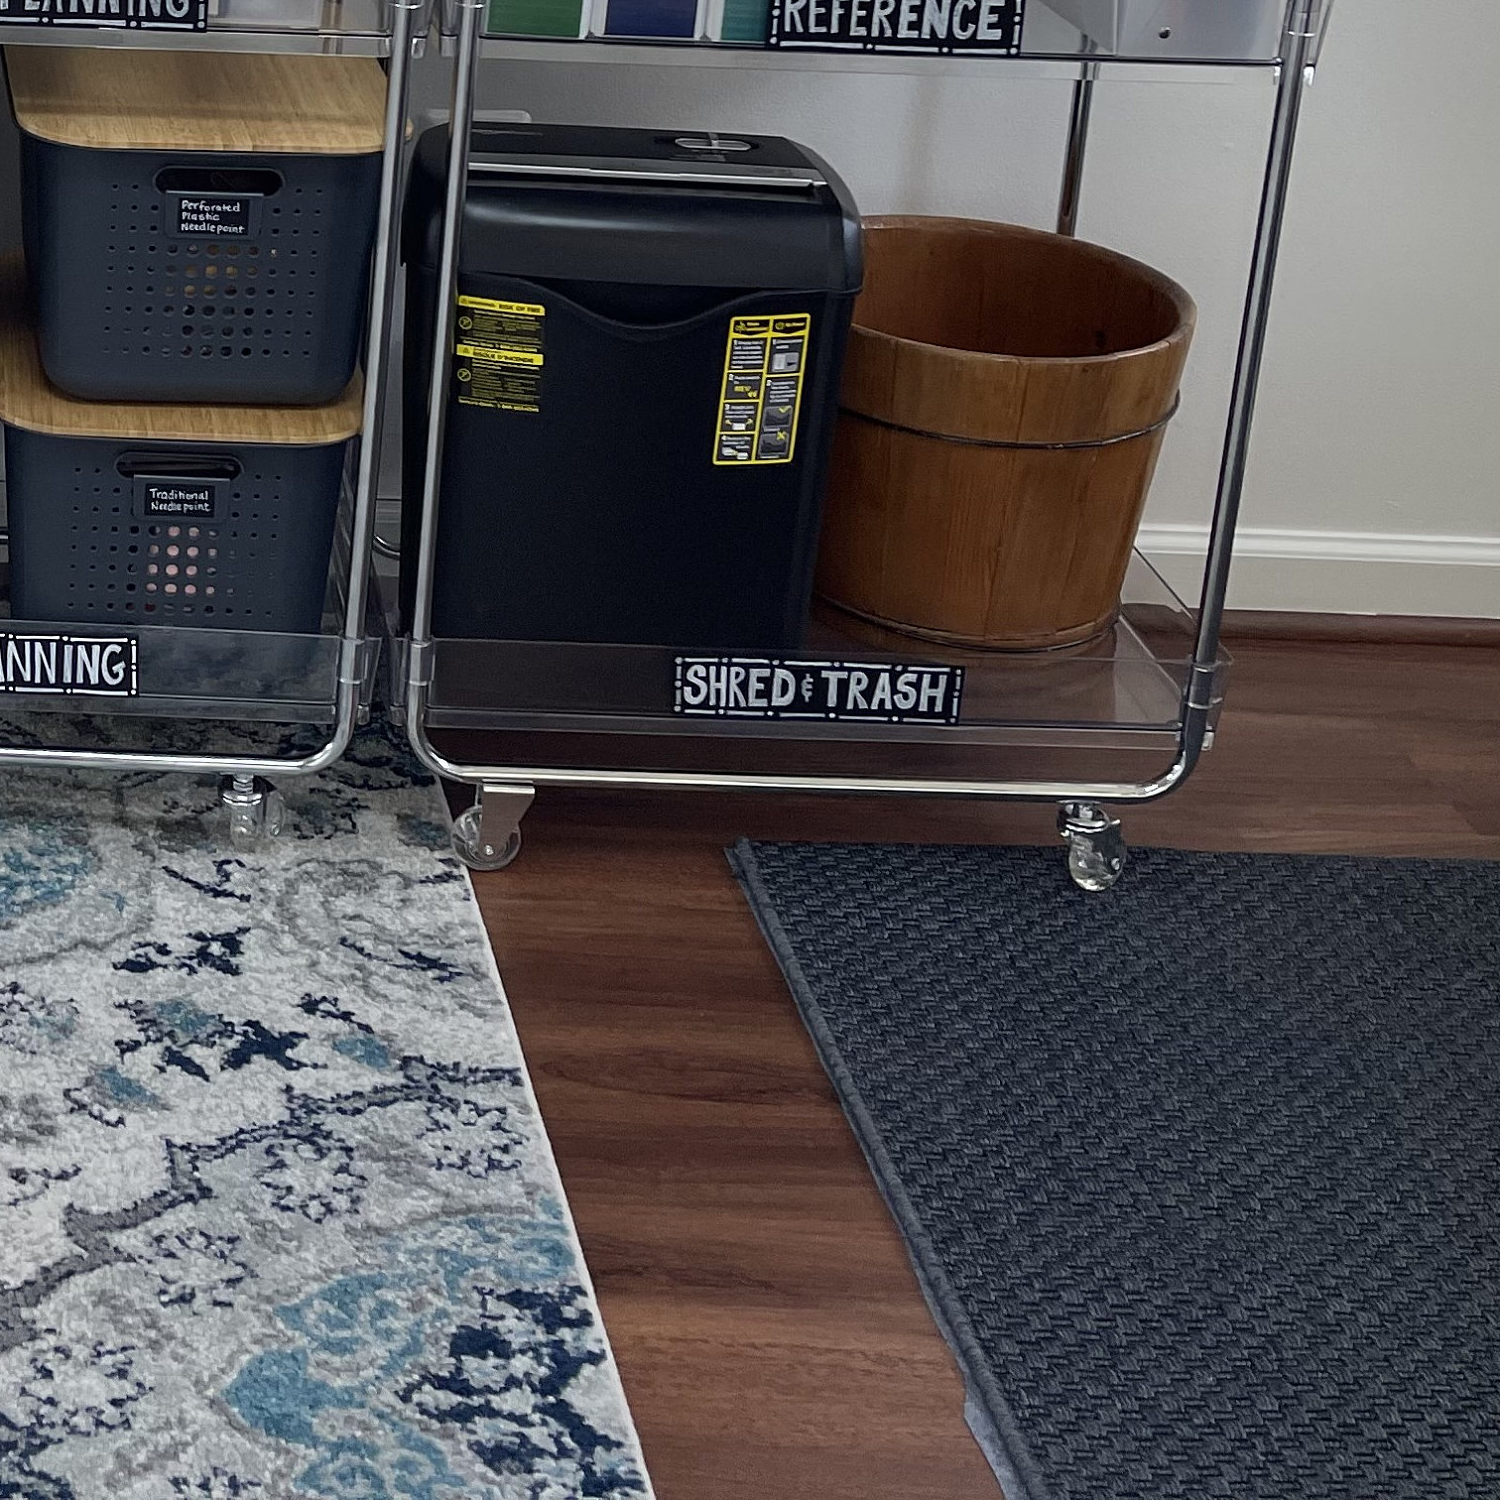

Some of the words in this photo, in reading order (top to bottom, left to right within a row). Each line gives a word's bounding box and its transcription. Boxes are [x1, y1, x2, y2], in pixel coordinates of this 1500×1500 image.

[181, 200, 241, 212] Perforated
[181, 211, 220, 221] Plastic
[181, 222, 245, 235] Needlepoint
[149, 488, 209, 501] Traditional
[683, 664, 796, 707] SHRED
[801, 673, 813, 703] &
[821, 670, 948, 712] TRASH
